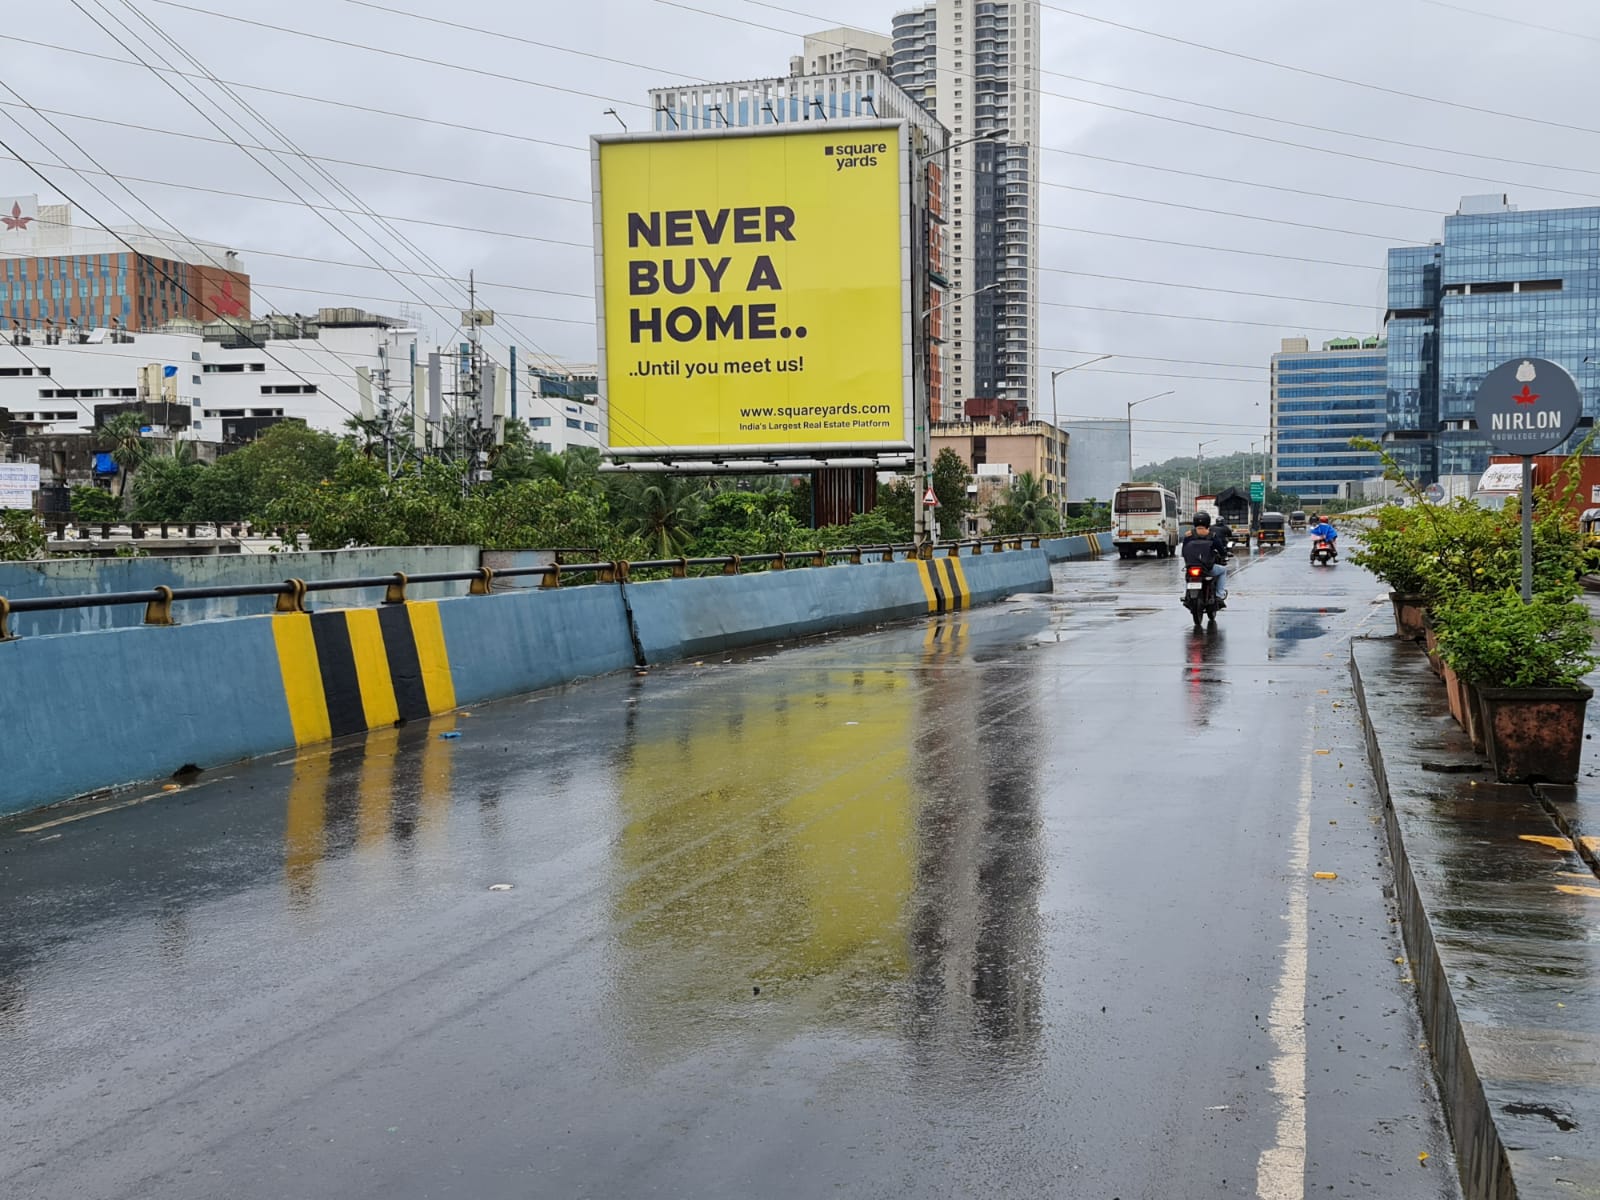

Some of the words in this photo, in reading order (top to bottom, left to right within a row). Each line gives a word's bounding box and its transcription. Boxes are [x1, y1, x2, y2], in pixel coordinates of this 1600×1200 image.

[836, 142, 887, 156] square
[836, 154, 878, 171] yards
[628, 205, 797, 248] NEVER
[628, 256, 732, 296] BUY
[746, 255, 782, 292] A
[630, 303, 808, 343] HOME..
[629, 360, 680, 376] ..Until
[685, 361, 719, 379] you
[724, 357, 772, 374] meet
[777, 356, 804, 372] us!
[740, 403, 890, 418] www.squareyards.com
[739, 422, 767, 431] India's
[768, 421, 801, 431] Largest
[803, 420, 822, 429] Real
[823, 420, 850, 429] Estate
[852, 419, 890, 428] Platform
[1492, 410, 1561, 430] NIRLON
[1491, 432, 1536, 440] KNOWLEDGE
[1540, 431, 1560, 439] PARK
